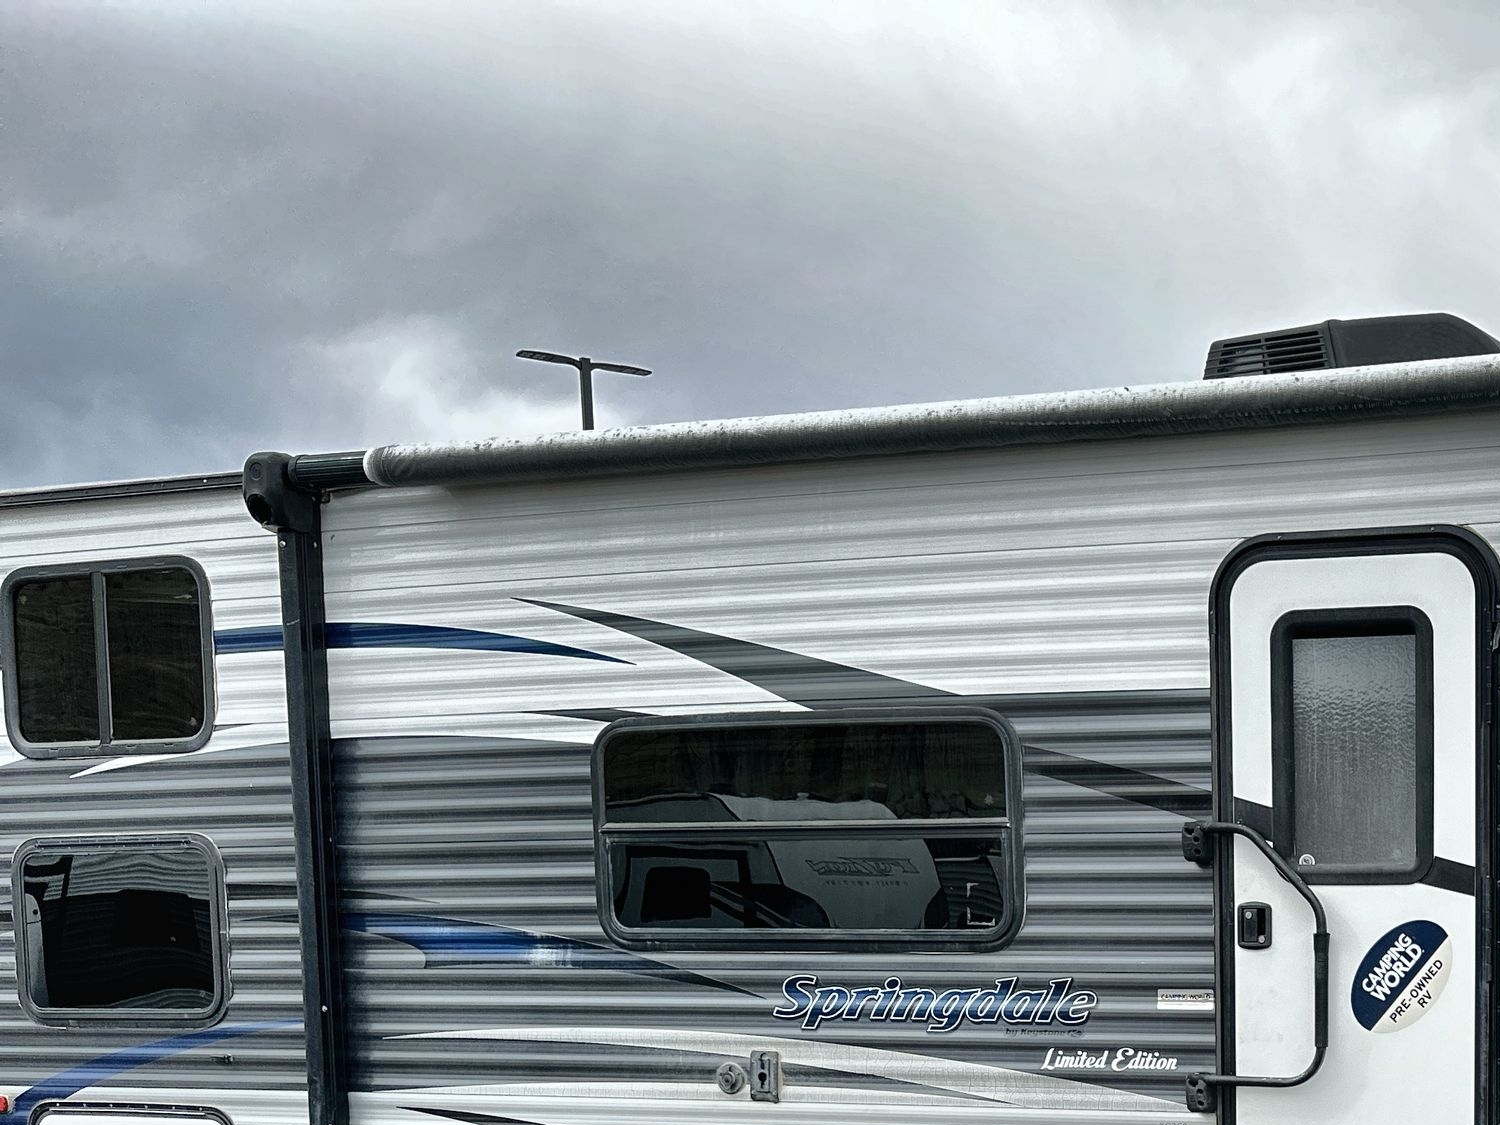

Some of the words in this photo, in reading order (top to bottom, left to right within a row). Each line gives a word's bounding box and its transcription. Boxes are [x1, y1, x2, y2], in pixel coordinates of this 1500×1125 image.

[1362, 933, 1412, 992] CAMPING
[1370, 944, 1422, 1001] WORLD
[773, 975, 1098, 1032] Springdale
[1389, 960, 1443, 1023] PRE-OWNED
[1417, 990, 1432, 1008] RV
[1040, 1047, 1109, 1070] Limited
[1111, 1047, 1178, 1072] Edition
